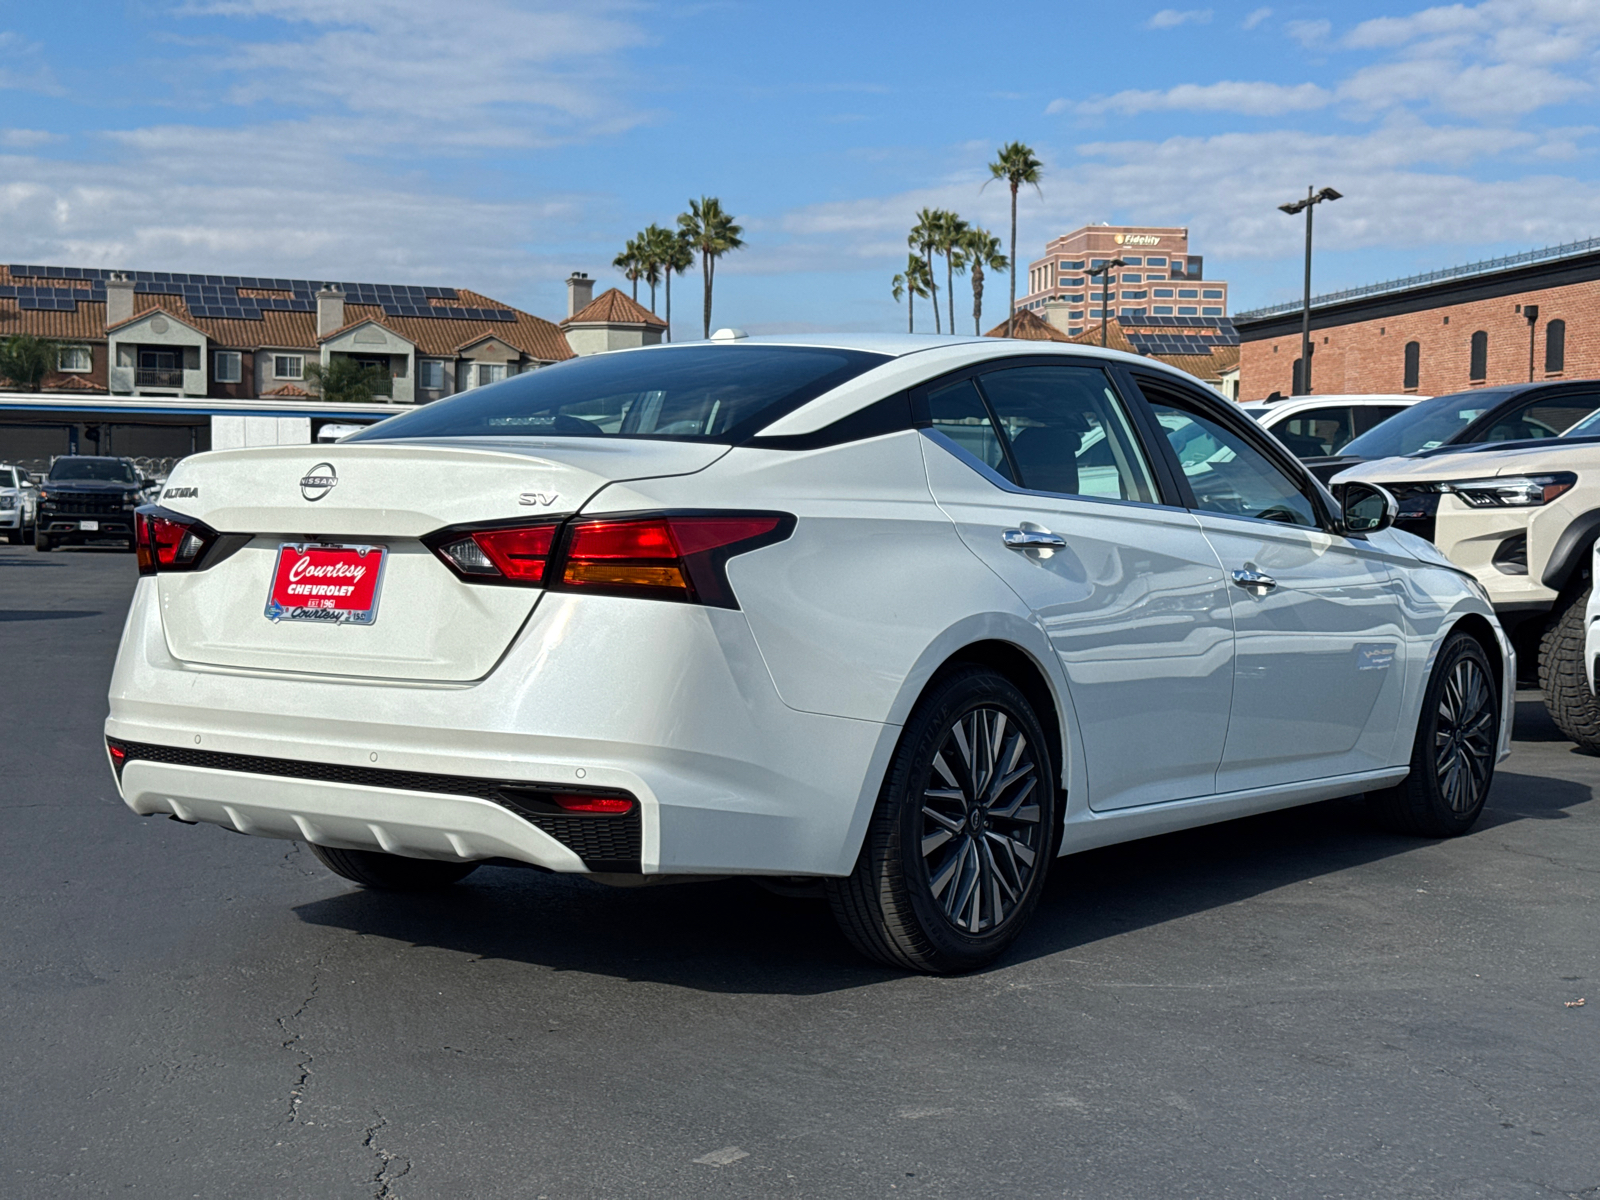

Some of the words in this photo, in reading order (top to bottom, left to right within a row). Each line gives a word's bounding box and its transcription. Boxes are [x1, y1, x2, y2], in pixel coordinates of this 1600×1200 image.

[1124, 234, 1161, 246] Fidelity
[301, 477, 338, 487] NISSAN
[518, 492, 559, 507] SV
[289, 556, 367, 584] Courtesy
[287, 584, 355, 597] CHEVROLET
[320, 599, 336, 608] 1961
[291, 606, 344, 621] Courtesy
